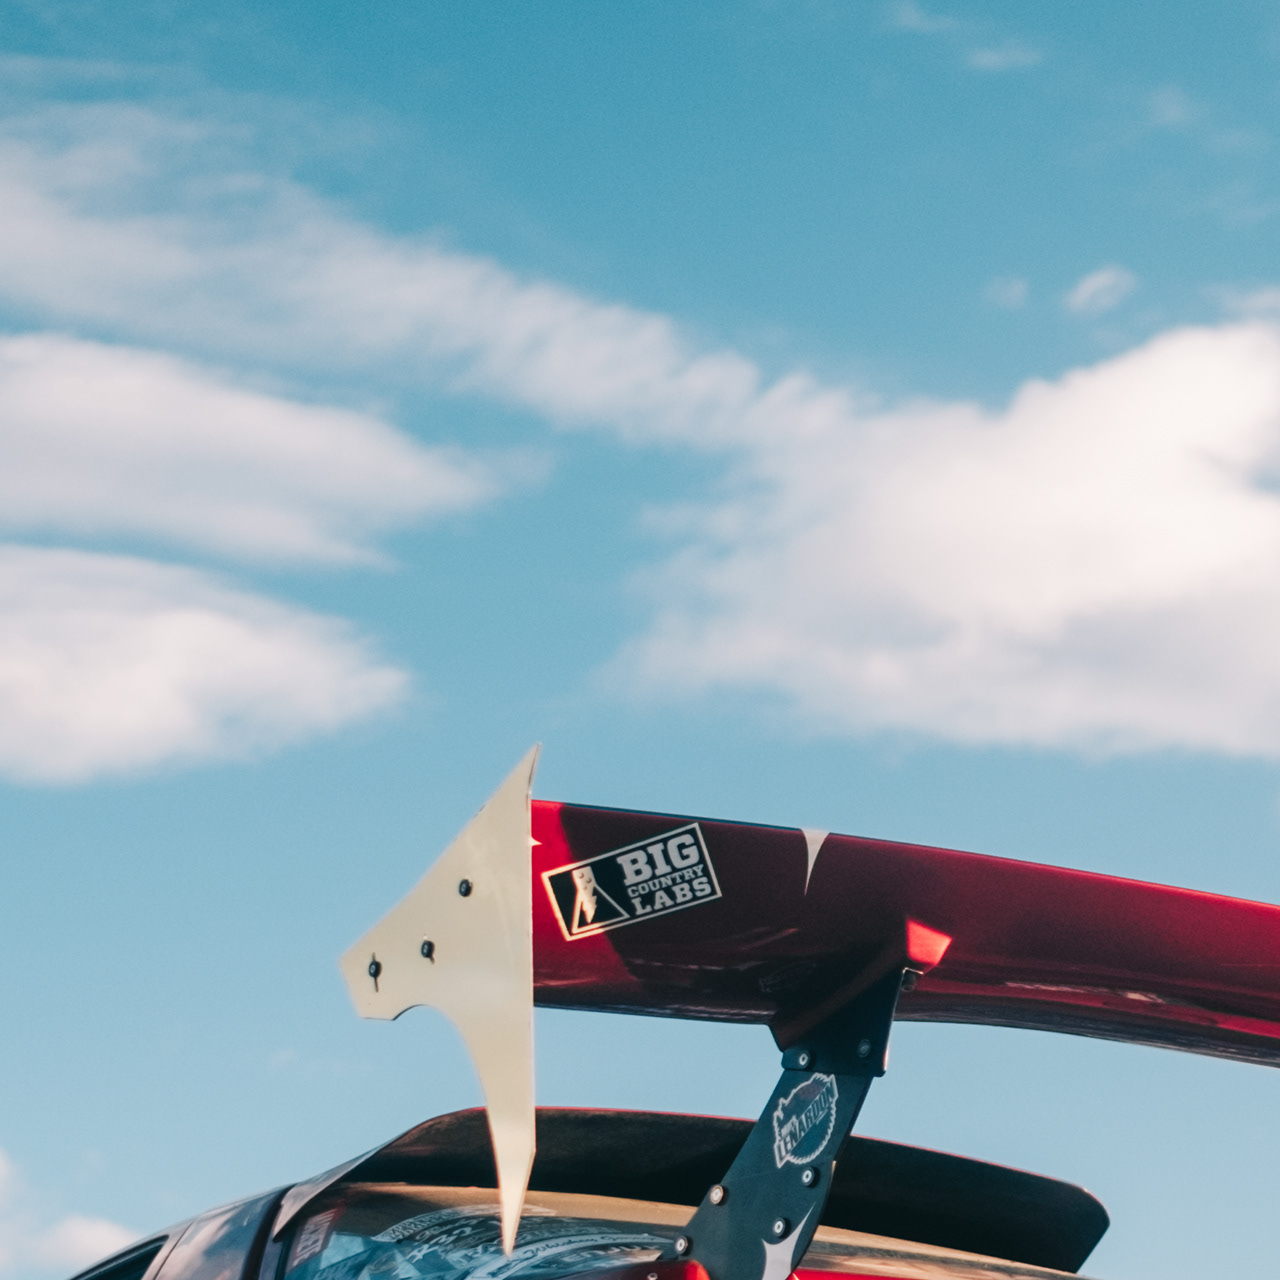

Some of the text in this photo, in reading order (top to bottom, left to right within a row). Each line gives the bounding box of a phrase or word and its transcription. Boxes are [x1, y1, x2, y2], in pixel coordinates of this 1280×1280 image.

[617, 833, 700, 886] BIG
[627, 864, 704, 898] COUNTRY
[631, 877, 712, 916] LABS
